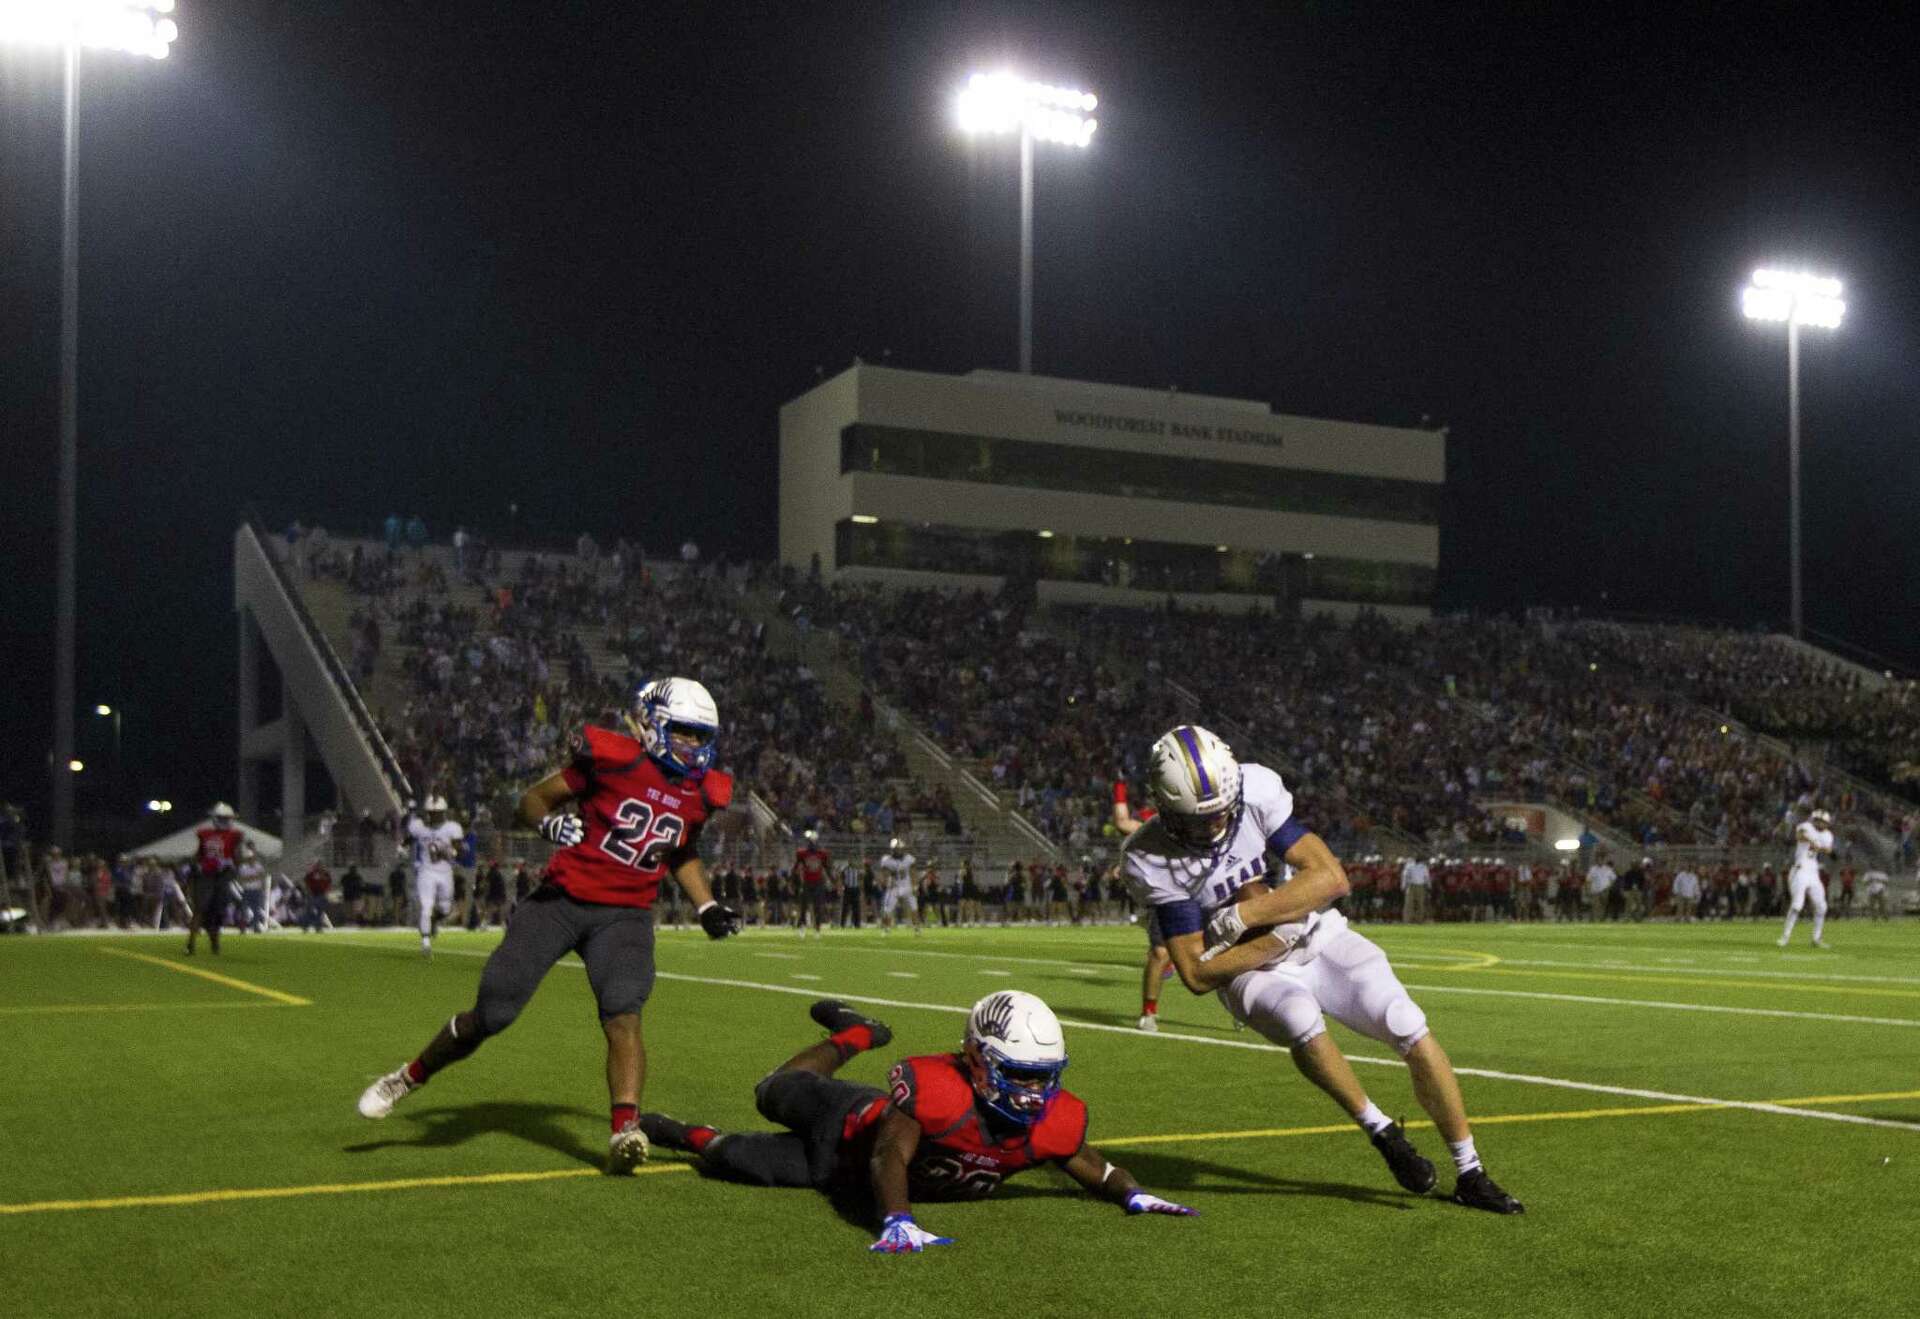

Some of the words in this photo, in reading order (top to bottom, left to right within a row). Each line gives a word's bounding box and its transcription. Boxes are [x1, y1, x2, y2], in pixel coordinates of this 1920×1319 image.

[1170, 422, 1211, 440] BANK
[1215, 426, 1284, 447] STADIUM
[600, 797, 684, 872] 22
[1213, 853, 1268, 903] BEAR
